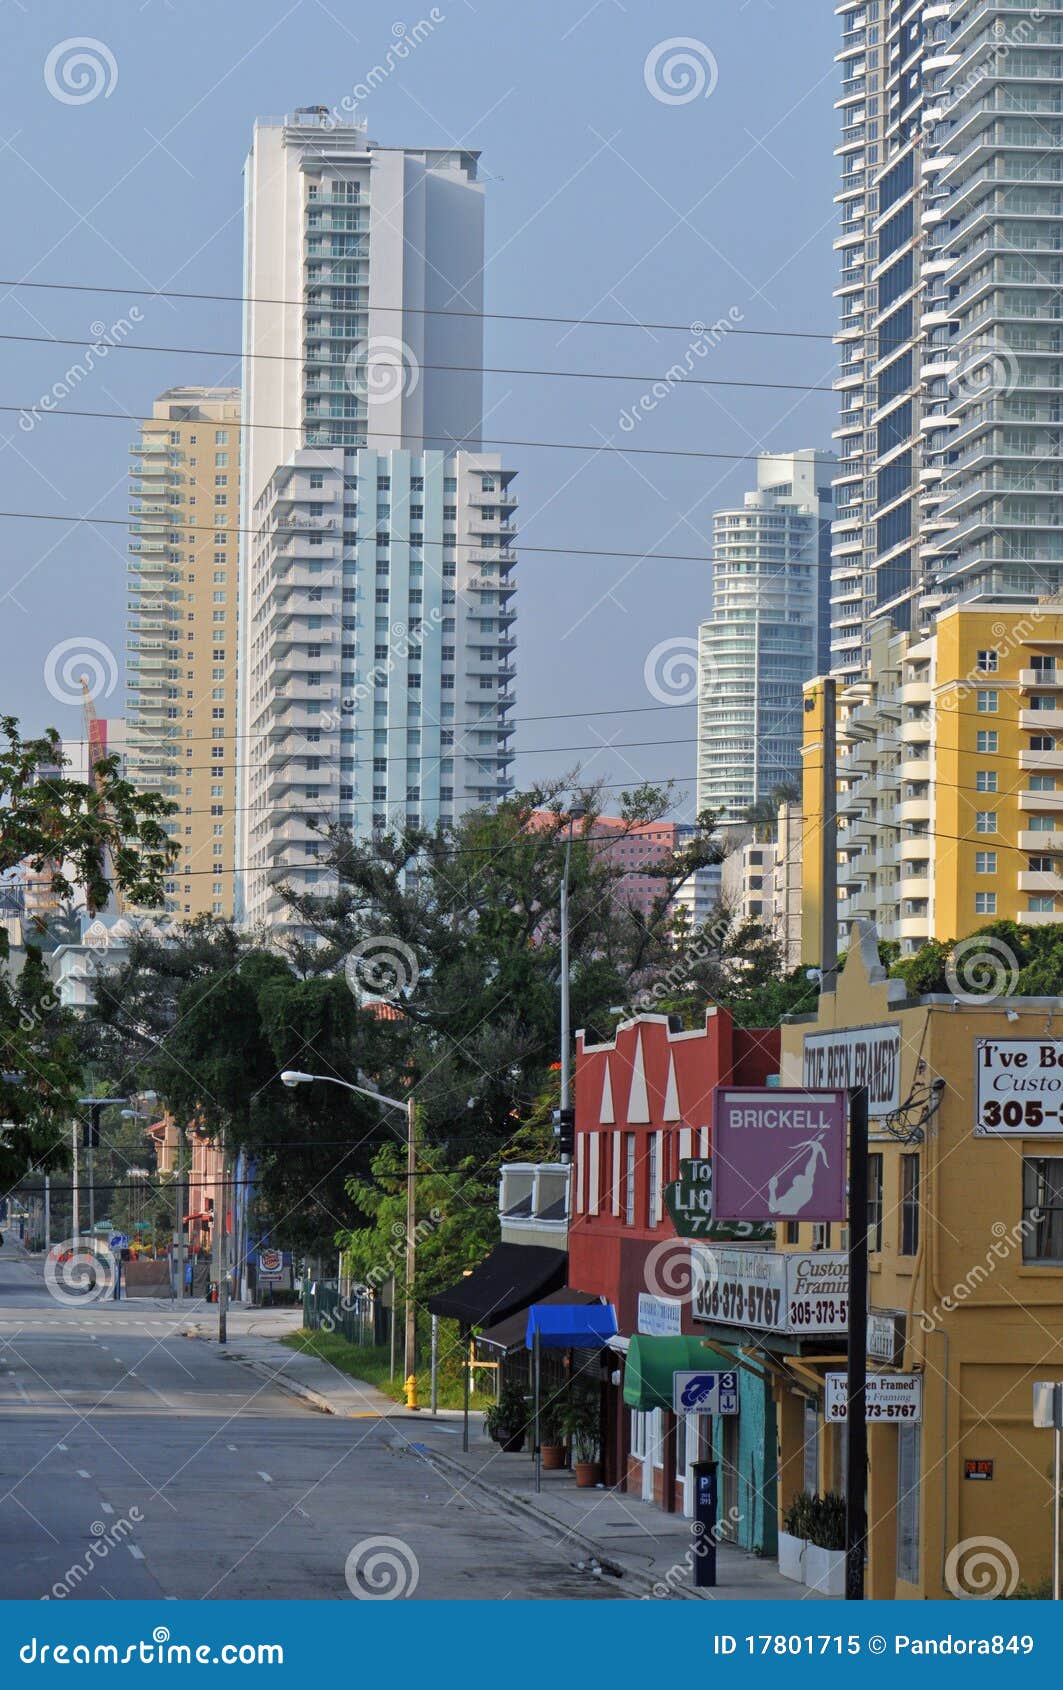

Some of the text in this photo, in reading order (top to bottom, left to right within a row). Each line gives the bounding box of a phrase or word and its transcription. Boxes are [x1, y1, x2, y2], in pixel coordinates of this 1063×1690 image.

[827, 1043, 852, 1088] BEEN
[983, 1045, 1028, 1068] I've
[992, 1073, 1063, 1092] Custo
[729, 1109, 831, 1129] BRICKELL
[983, 1100, 1063, 1128] 305-
[687, 1160, 712, 1182] To
[675, 1182, 713, 1213] LIQ
[790, 1300, 849, 1324] 305-373-5
[722, 1373, 734, 1389] 3
[874, 1392, 911, 1402] Framing
[831, 1404, 917, 1417] 3073-5767
[700, 1476, 709, 1489] P
